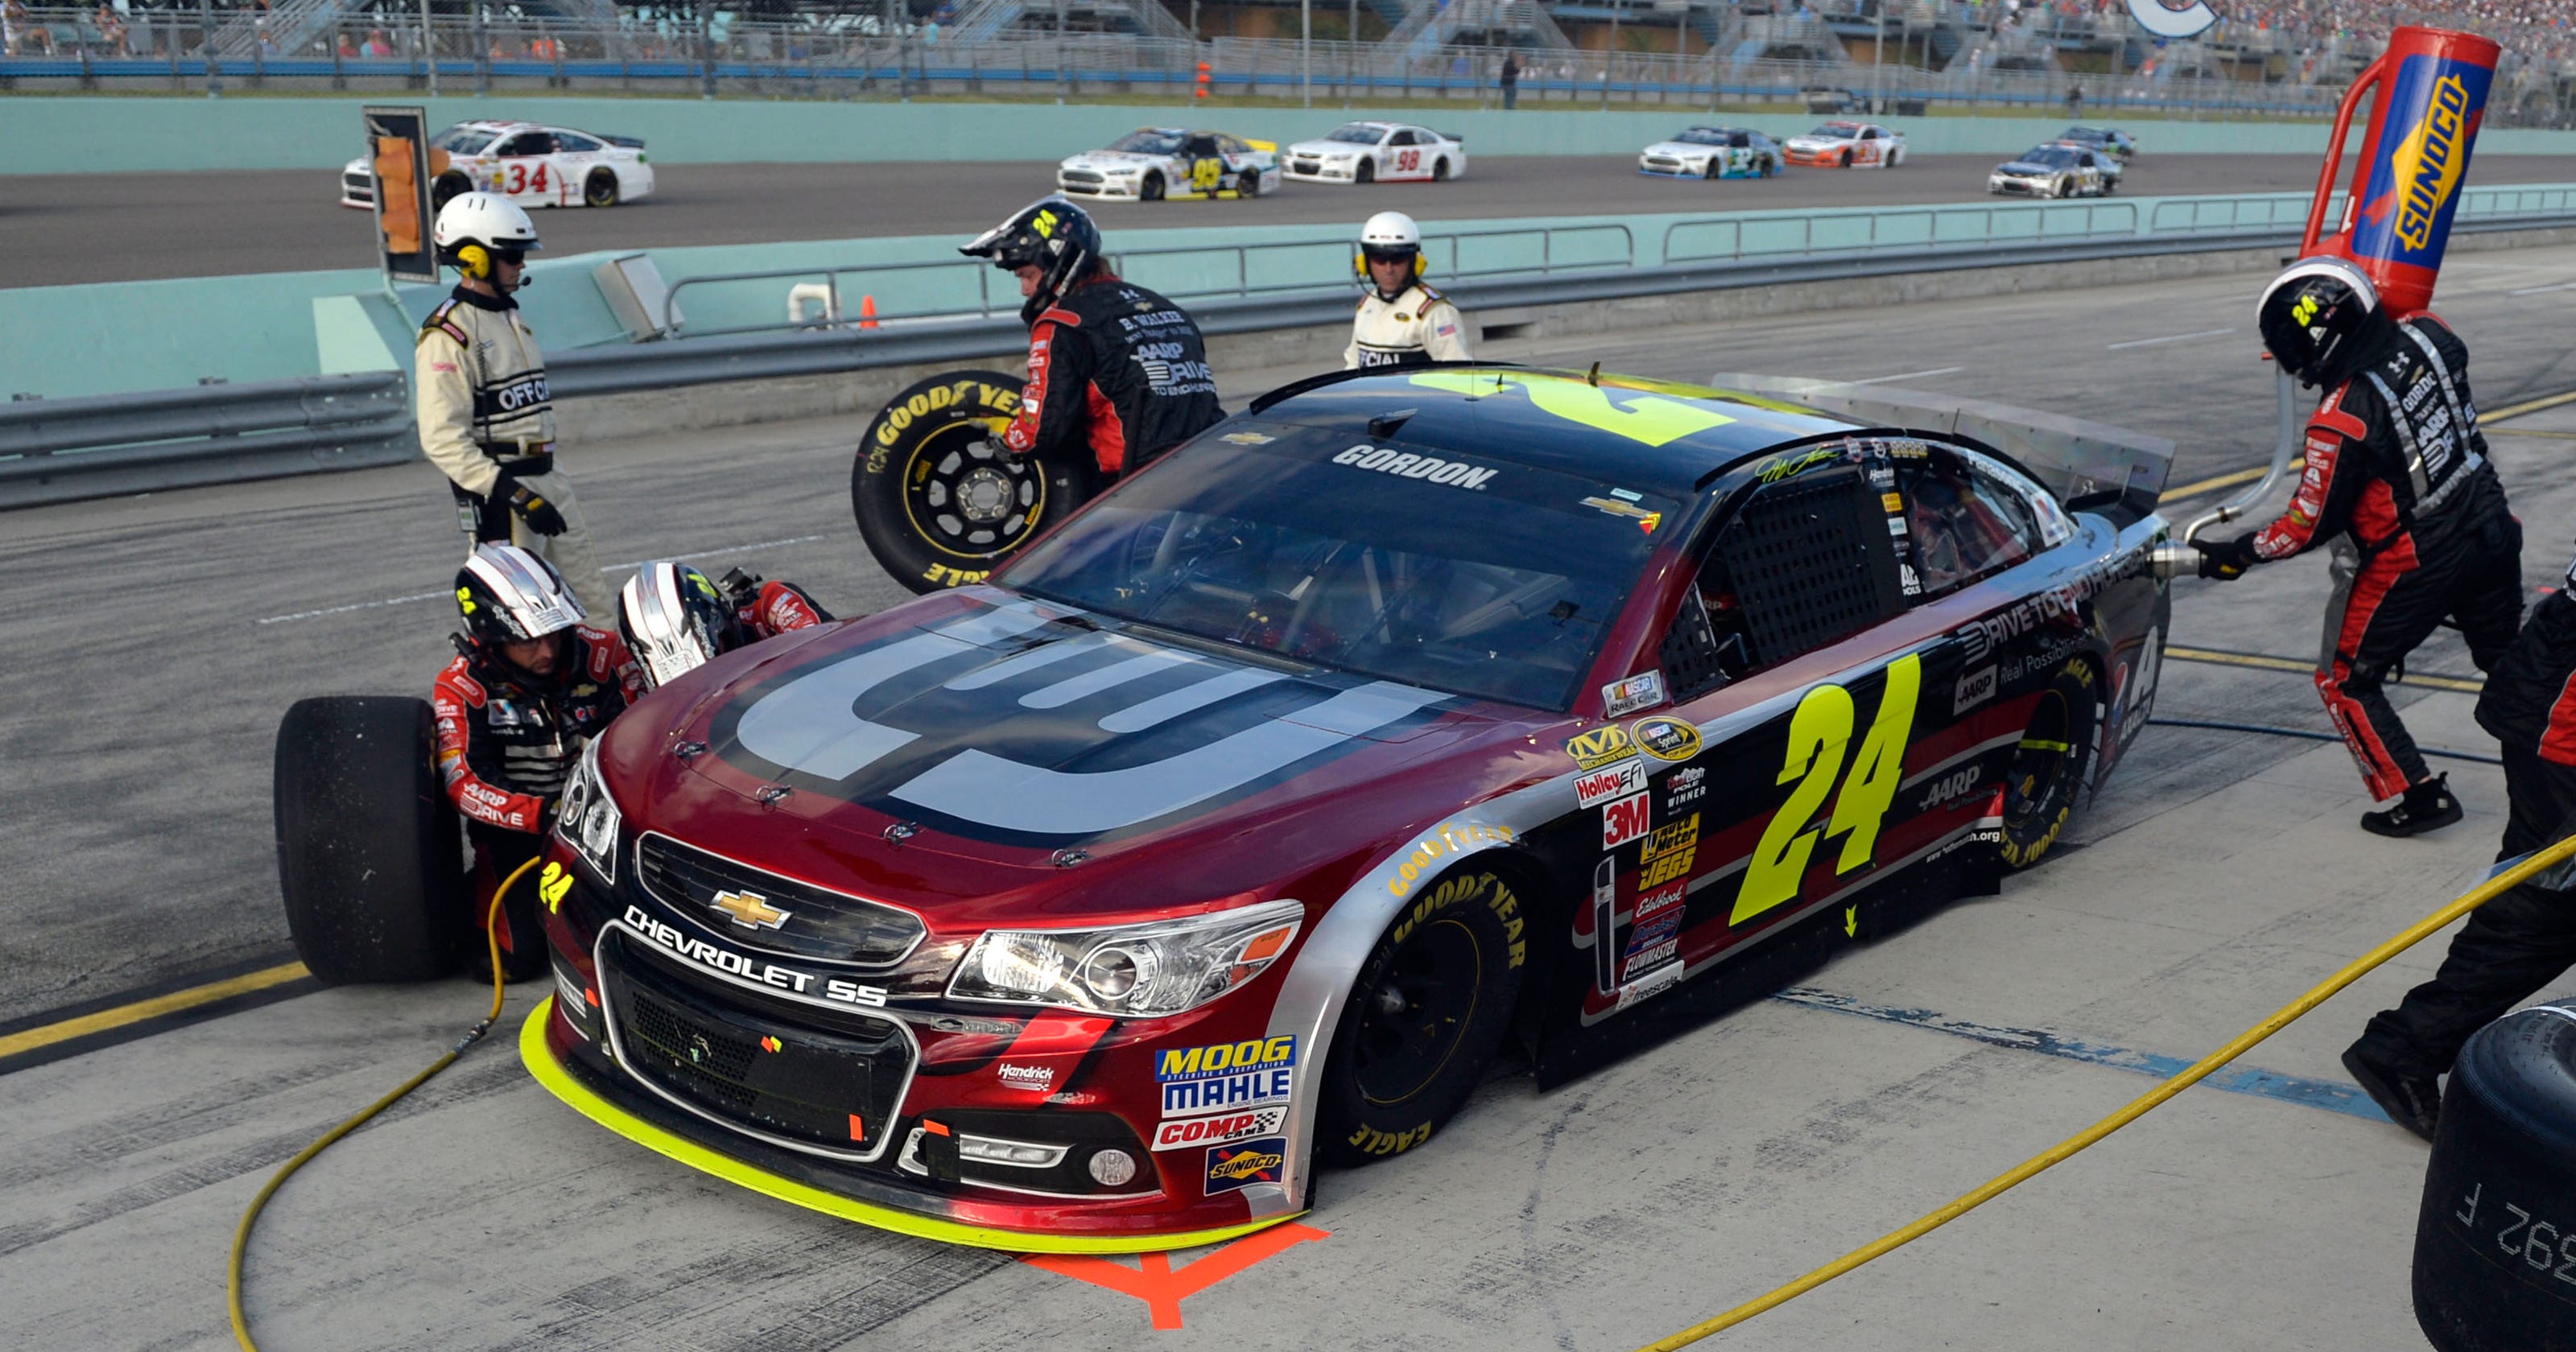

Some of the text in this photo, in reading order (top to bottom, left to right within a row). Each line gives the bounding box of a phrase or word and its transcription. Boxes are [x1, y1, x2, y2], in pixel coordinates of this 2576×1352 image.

[1396, 151, 1421, 171] 98
[2401, 81, 2465, 244] SUNOCO
[506, 163, 547, 195] 34
[1033, 209, 1058, 238] 24
[2292, 295, 2318, 327] 24
[1332, 444, 1499, 489] GORDON
[456, 586, 477, 615] 24
[1611, 692, 1658, 713] RACE CAR
[1958, 674, 1992, 705] AARP
[1657, 733, 1682, 749] Sprint
[464, 781, 507, 807] AARP
[1575, 773, 1621, 801] Holley
[1620, 762, 1642, 789] EFI
[1667, 785, 1706, 808] WINNER
[1728, 652, 1922, 928] 24
[1919, 765, 1980, 812] AARP
[460, 792, 524, 826] DRIVE
[1605, 793, 1649, 846] 3M
[1389, 822, 1513, 897] GOODYEAR
[1637, 846, 1697, 892] JEGS
[539, 861, 575, 915] 24
[1636, 884, 1683, 918] Edelbrock
[624, 905, 887, 1008] CHEVROLET SS
[1622, 938, 1678, 982] FLOWMASTER
[997, 1063, 1055, 1080] Hendrick
[1160, 1036, 1293, 1075] MOOG
[1167, 1070, 1213, 1081] STEERING
[1229, 1061, 1286, 1074] SUSPENSION
[1164, 1070, 1290, 1111] MAHLE
[1228, 1094, 1289, 1109] ENGINE BEARINGS
[1159, 1114, 1255, 1145] COMP
[1224, 1125, 1266, 1140] CAMS
[1348, 1119, 1432, 1156] EAGLE
[1212, 1156, 1278, 1177] SUNOCO
[2455, 1182, 2483, 1228] F
